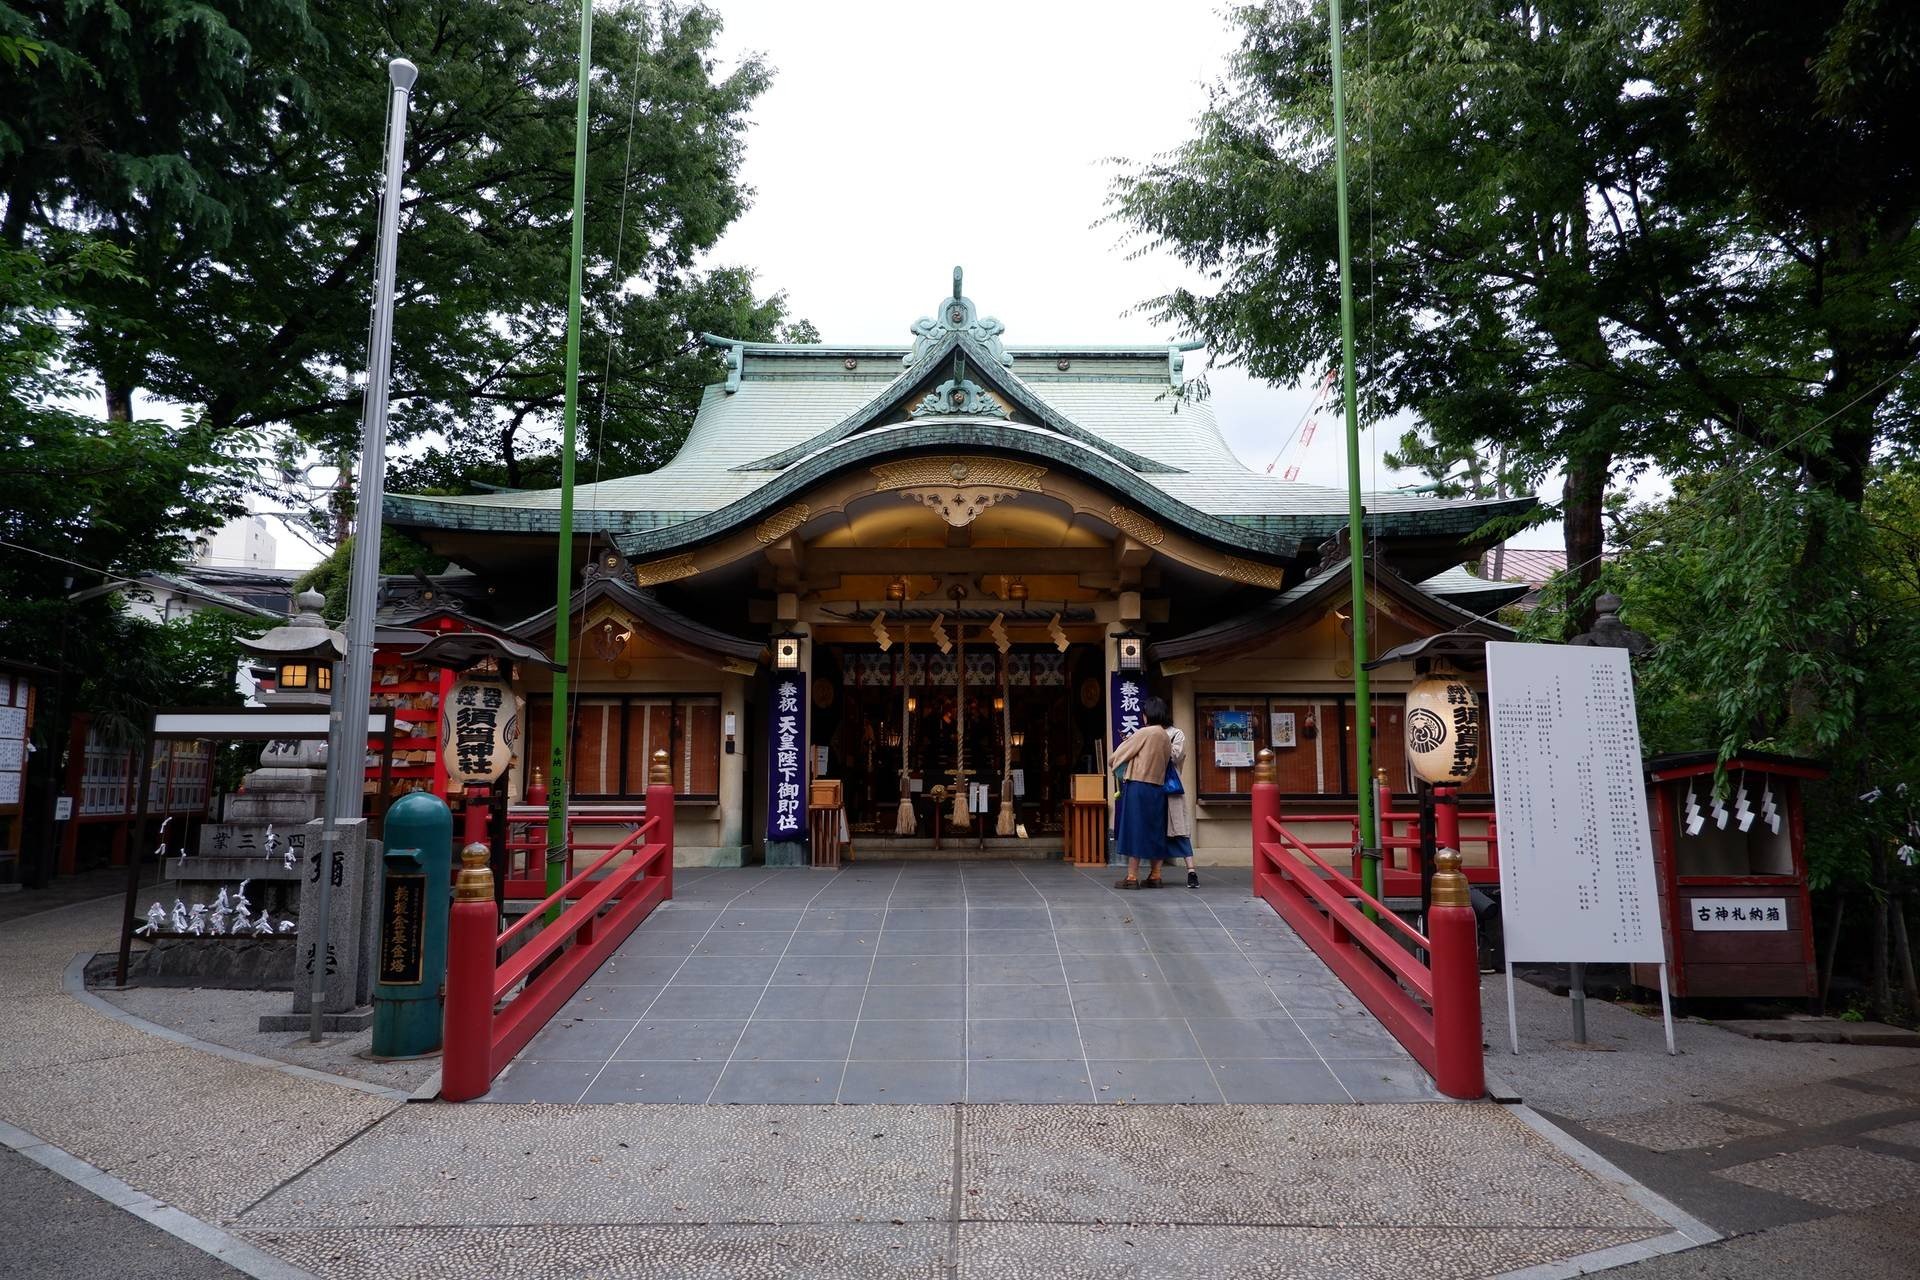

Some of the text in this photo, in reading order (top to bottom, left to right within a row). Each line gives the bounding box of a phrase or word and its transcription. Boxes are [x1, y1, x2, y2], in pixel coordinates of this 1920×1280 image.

[482, 686, 503, 708] 四谷
[1120, 680, 1141, 738] 奉祝天
[456, 707, 498, 774] 須賀神社
[777, 681, 800, 831] 奉祝天皇陛下御即位
[1697, 906, 1780, 921] 古神札納箱
